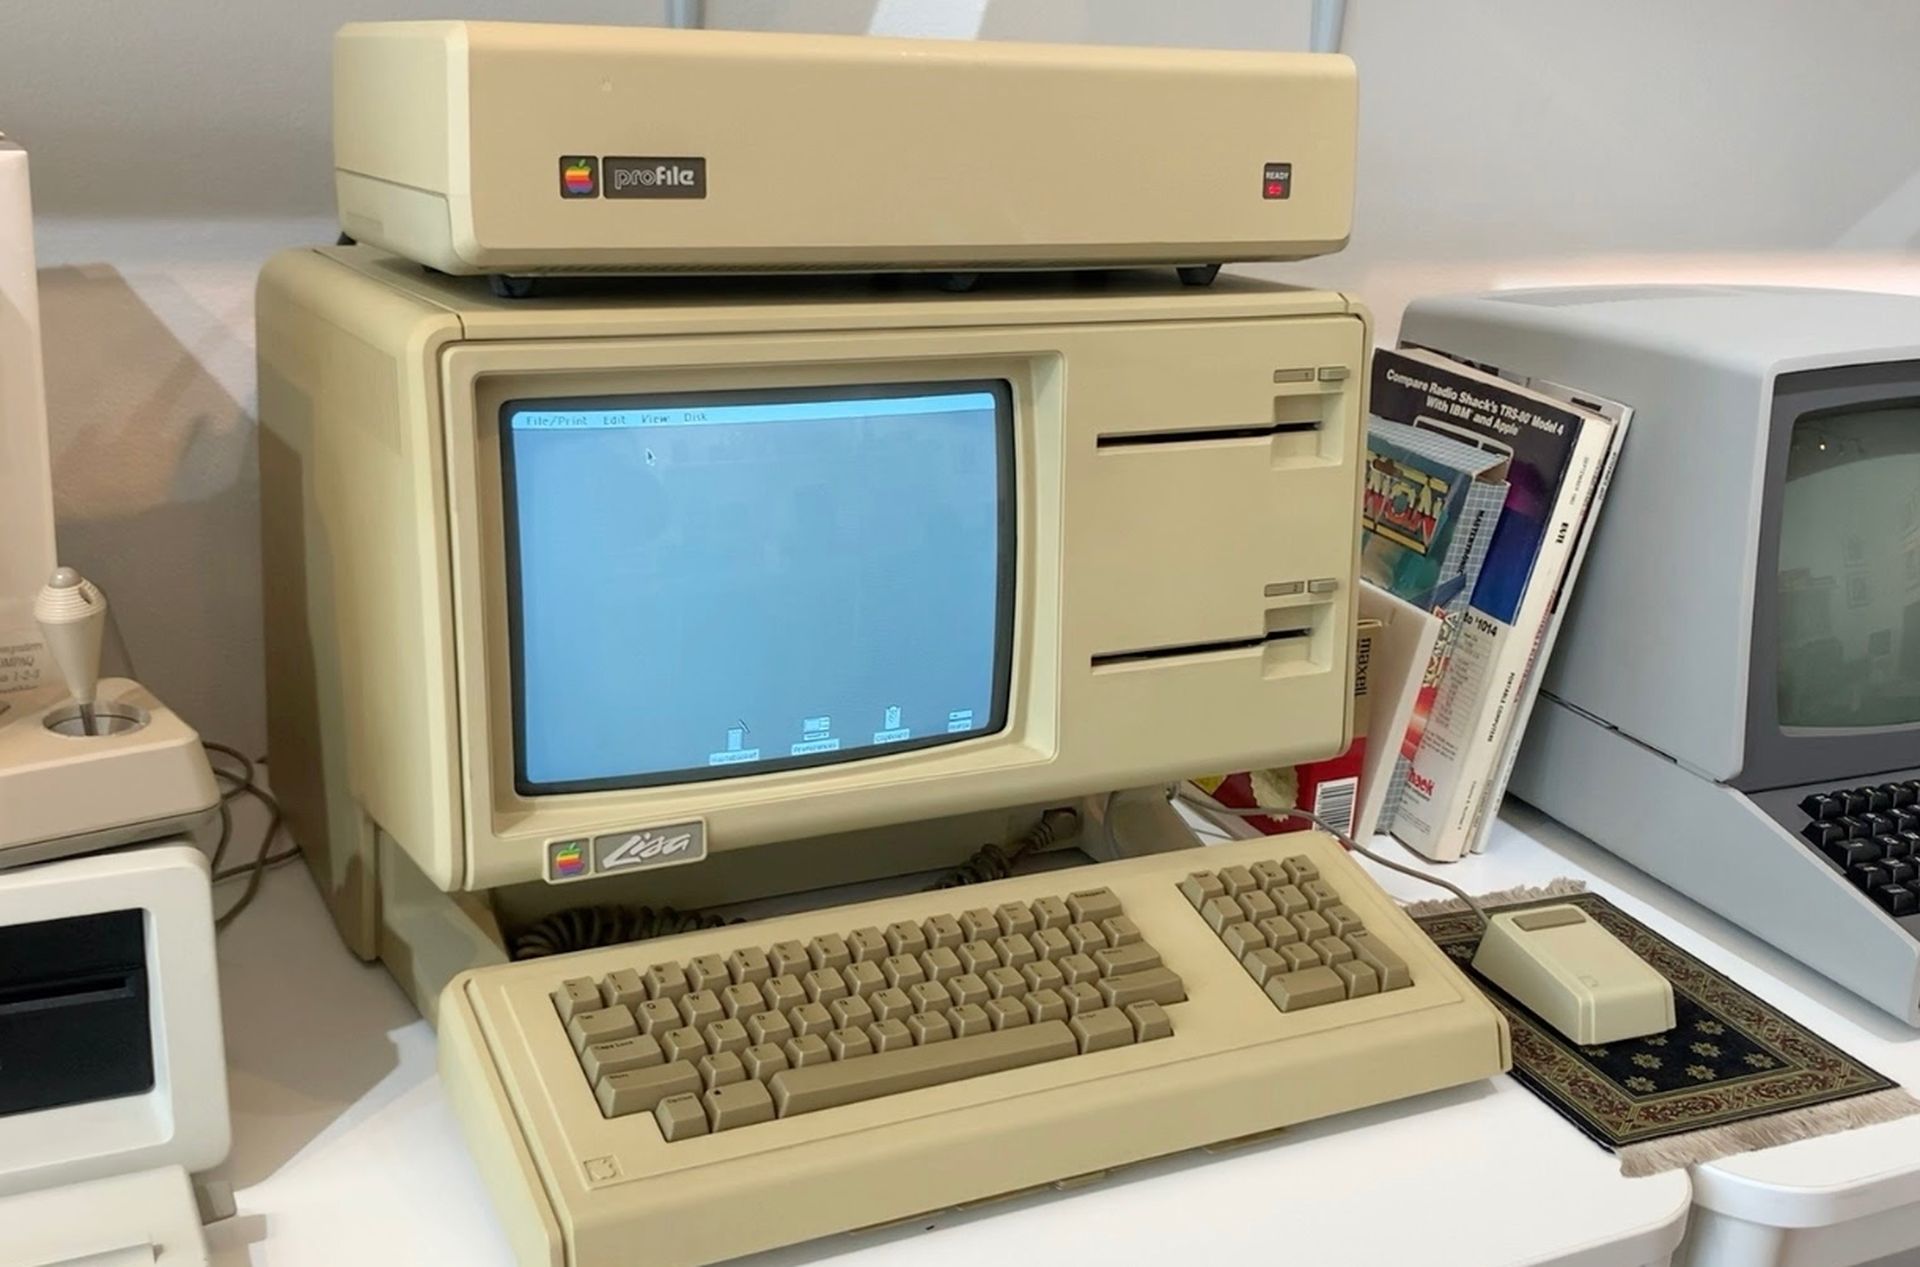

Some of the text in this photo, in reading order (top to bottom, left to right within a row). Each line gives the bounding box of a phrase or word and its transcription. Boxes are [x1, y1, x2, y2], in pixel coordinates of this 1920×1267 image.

[526, 412, 708, 427] File/Print Edit View Disk
[1386, 368, 1429, 392] Compare
[1429, 382, 1457, 401] Radio
[1458, 391, 1498, 414] Shack's
[1531, 415, 1557, 434] Model
[1557, 425, 1565, 437] 4
[1426, 396, 1520, 437] With IBM and Apple
[1355, 638, 1371, 697] maxell
[1487, 672, 1516, 742] PORTABLE COMPUTERS
[1407, 766, 1434, 796] hack
[602, 832, 691, 869] Lisa
